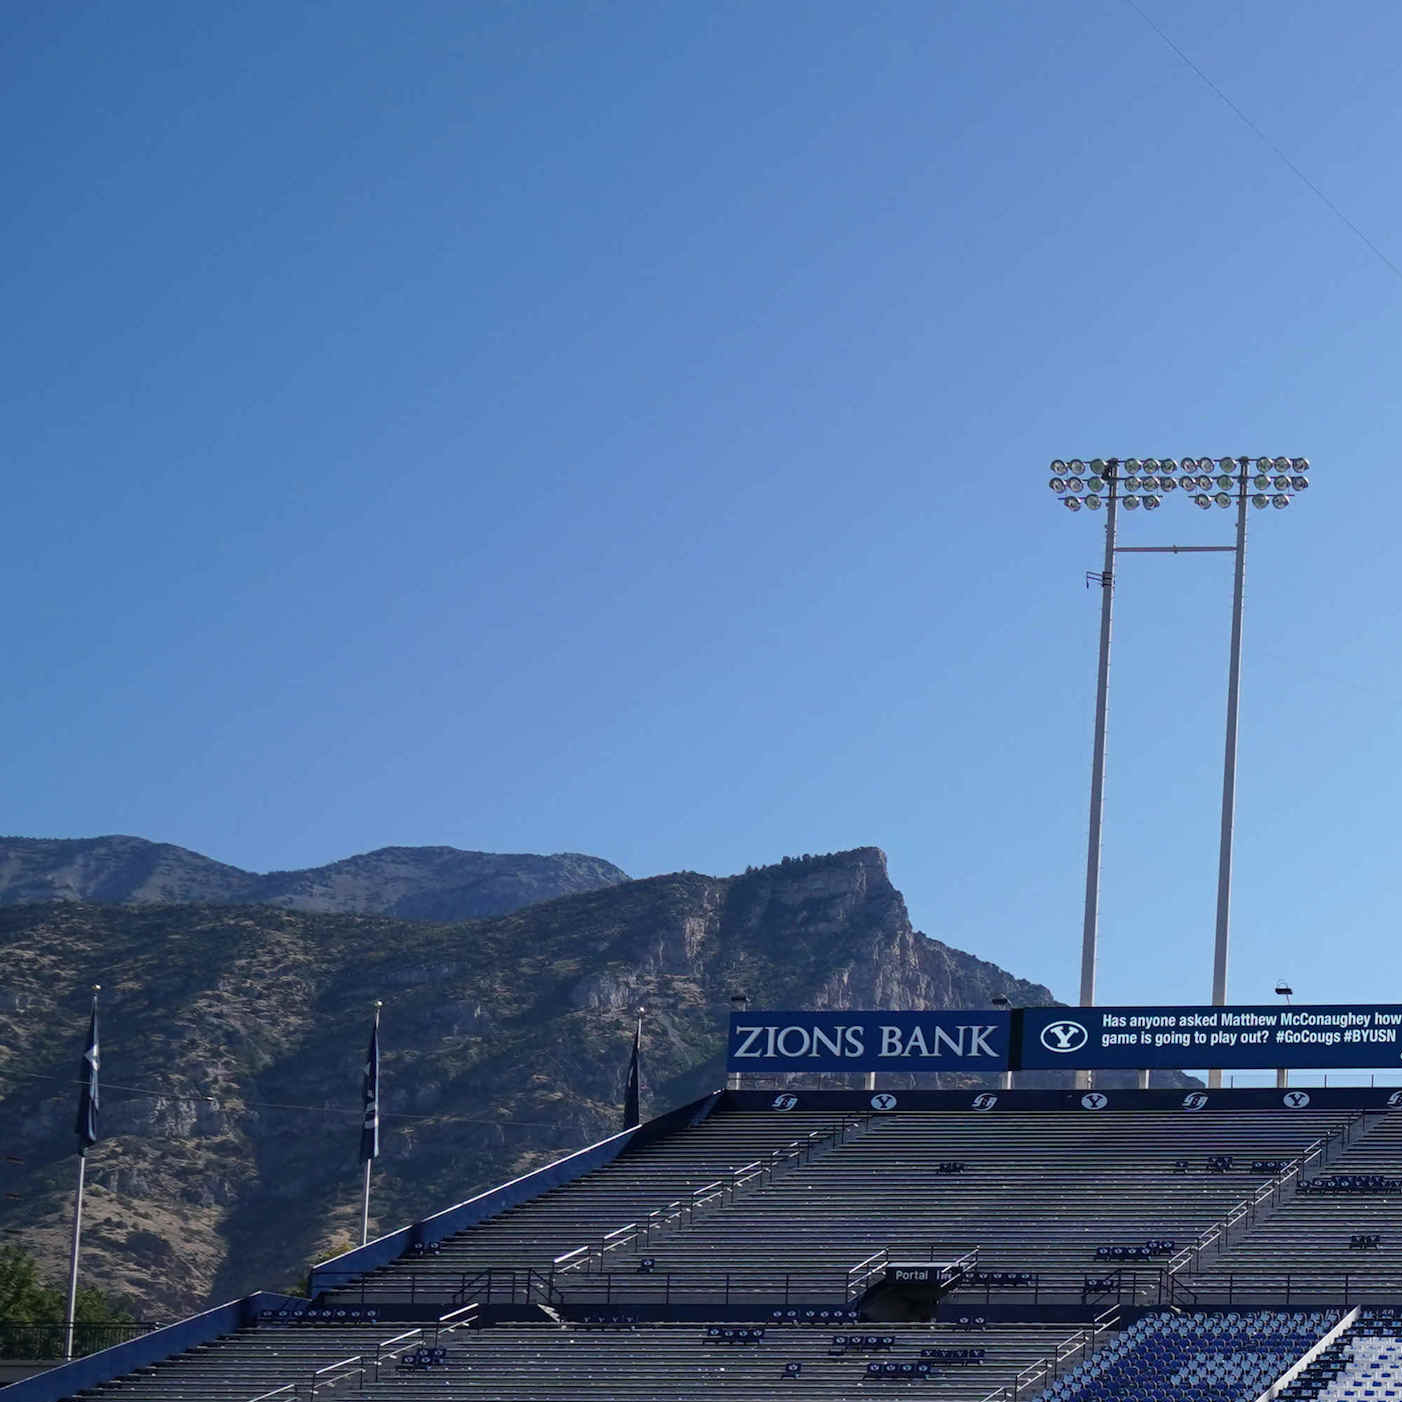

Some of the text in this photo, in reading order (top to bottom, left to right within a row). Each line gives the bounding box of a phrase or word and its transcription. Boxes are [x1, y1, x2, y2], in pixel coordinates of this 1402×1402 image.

[1102, 1014, 1126, 1027] Has
[1129, 1014, 1176, 1029] anyone
[1178, 1013, 1217, 1026] asked
[1220, 1013, 1277, 1026] Matthew
[1280, 1012, 1371, 1028] McConaughey
[1374, 1012, 1402, 1025] how
[733, 1025, 999, 1058] ZIONS BANK
[1101, 1029, 1396, 1047] game is going to play out? #GoCougs #BYUSN
[895, 1270, 929, 1280] Portal
